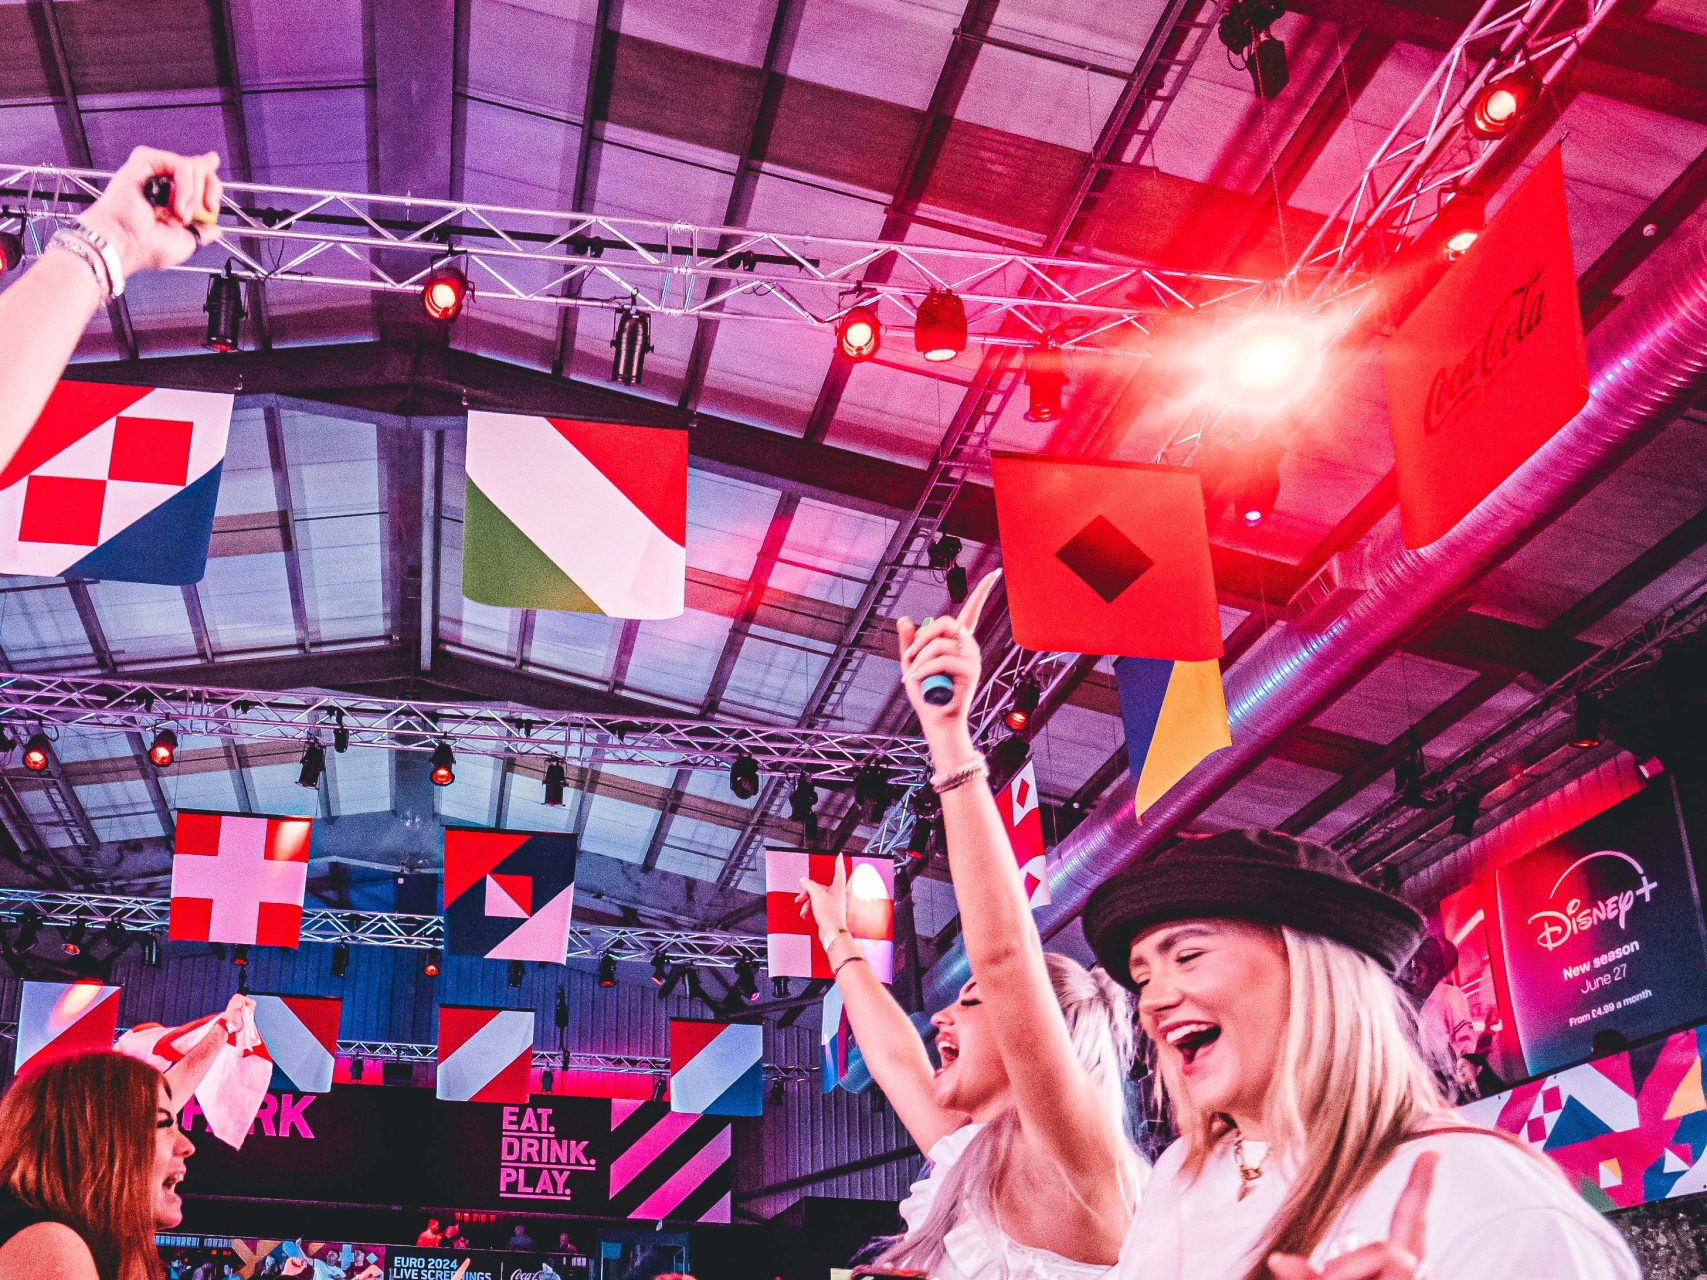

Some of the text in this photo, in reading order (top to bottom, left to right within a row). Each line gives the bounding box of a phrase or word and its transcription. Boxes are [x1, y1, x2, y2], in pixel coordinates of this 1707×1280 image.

[1424, 265, 1545, 436] Coca-Cola
[1562, 940, 1640, 981] New season
[1581, 963, 1627, 994] June 27
[1569, 1012, 1591, 1027] From
[1623, 988, 1653, 1006] month
[502, 1106, 555, 1132] EAT.
[501, 1137, 596, 1166] DRINK.
[500, 1168, 571, 1195] PLAY.
[393, 1268, 419, 1280] LIVE
[394, 1256, 458, 1270] EURO 2024
